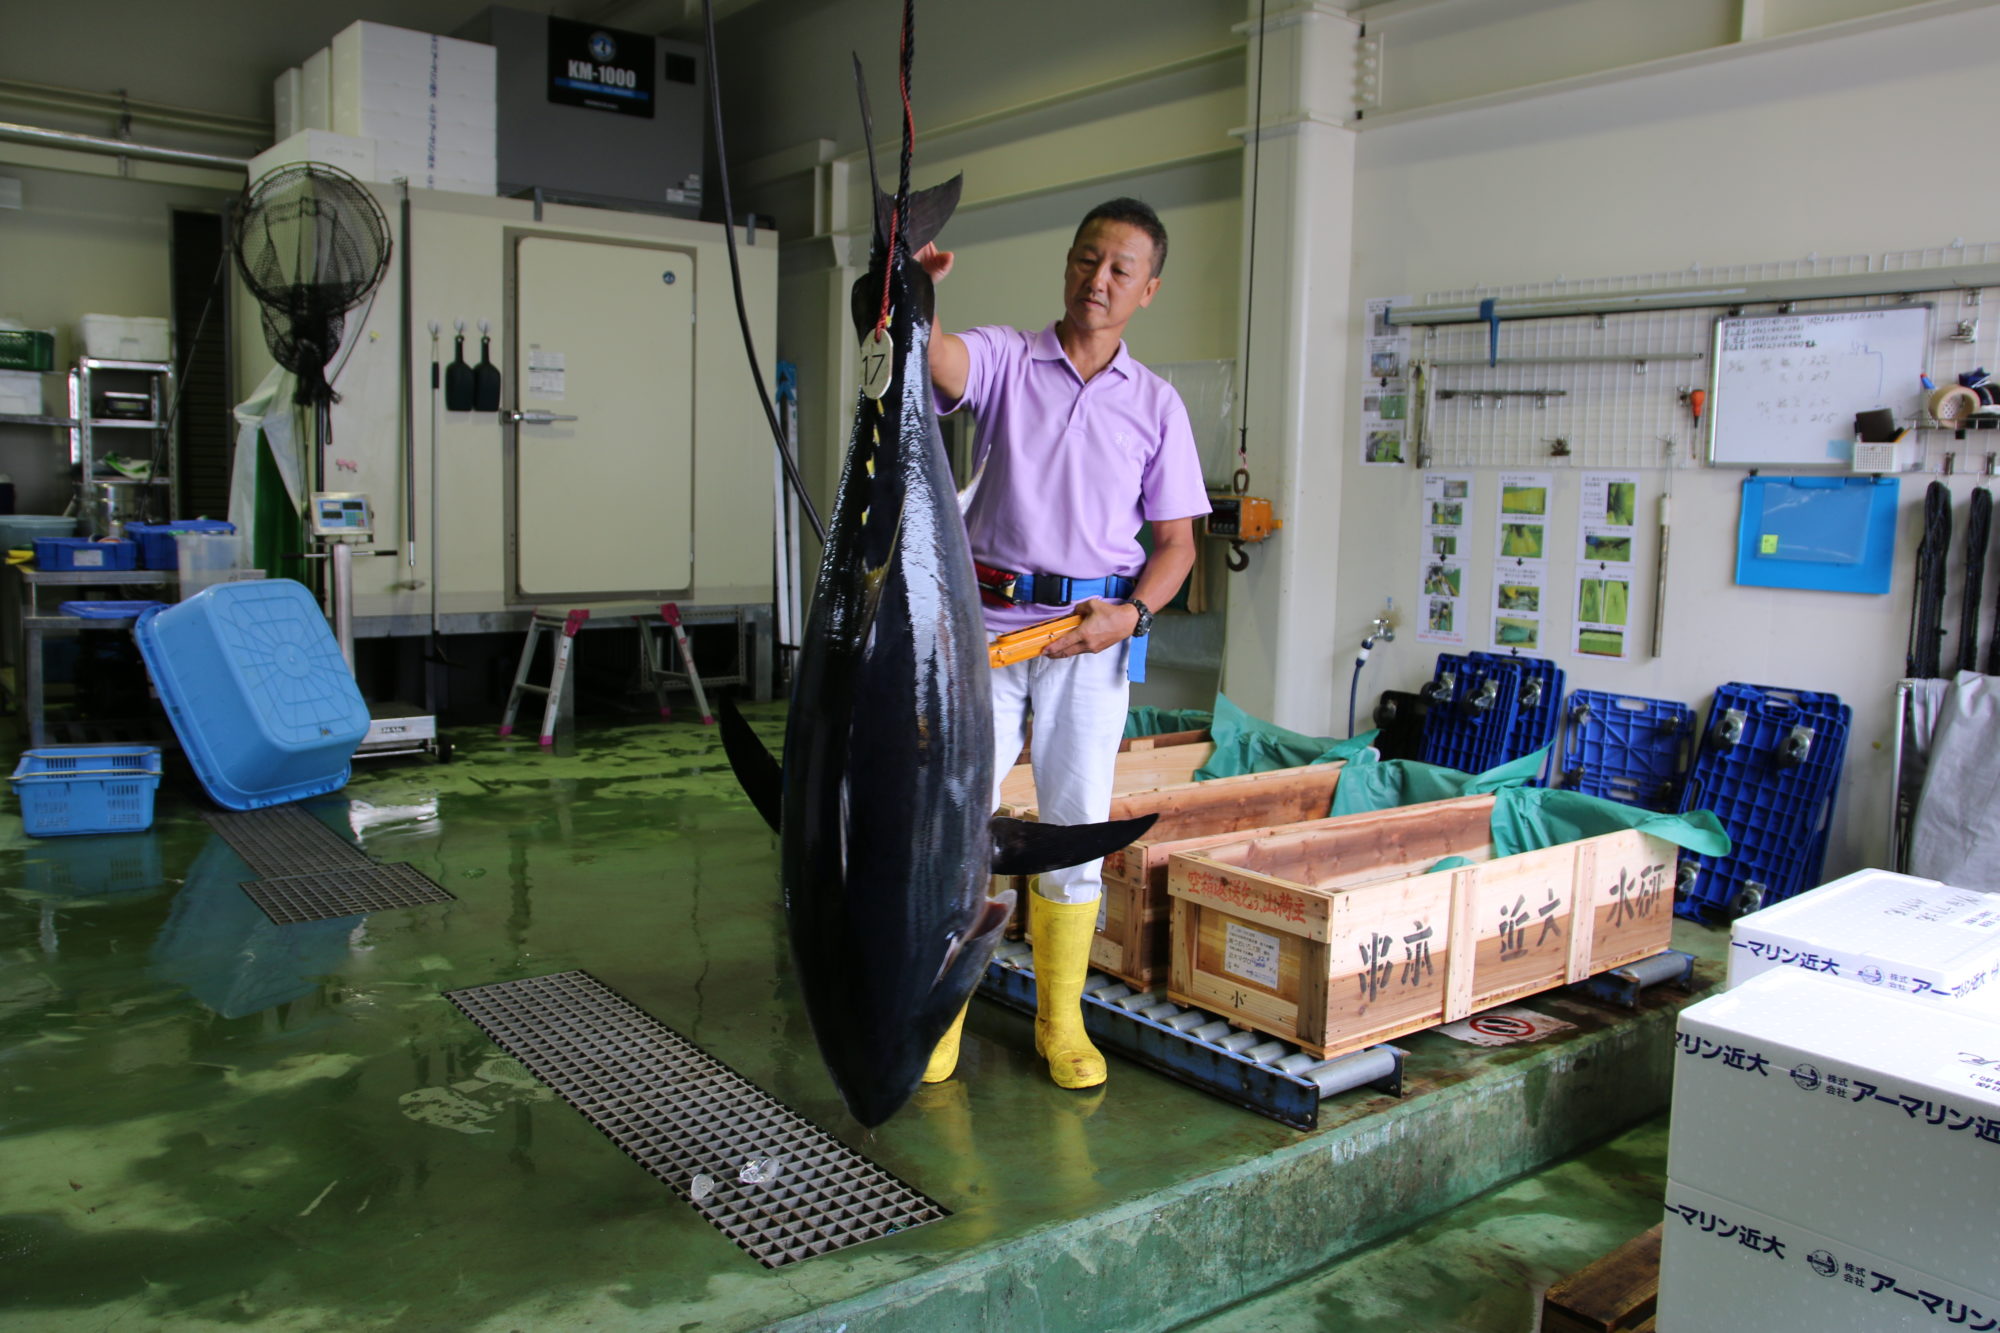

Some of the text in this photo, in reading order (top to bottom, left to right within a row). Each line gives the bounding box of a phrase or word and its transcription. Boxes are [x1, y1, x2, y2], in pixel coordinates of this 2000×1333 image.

[568, 59, 636, 88] KM-1000
[862, 353, 886, 386] 17
[1499, 887, 1561, 962] 近大
[1606, 863, 1666, 928] 水研
[1730, 935, 1840, 976] ーマリン近大
[1825, 1085, 1847, 1098] 会社
[1827, 1074, 1848, 1087] 株式
[1843, 1273, 1865, 1287] 会社
[1845, 1262, 1866, 1278] 株式
